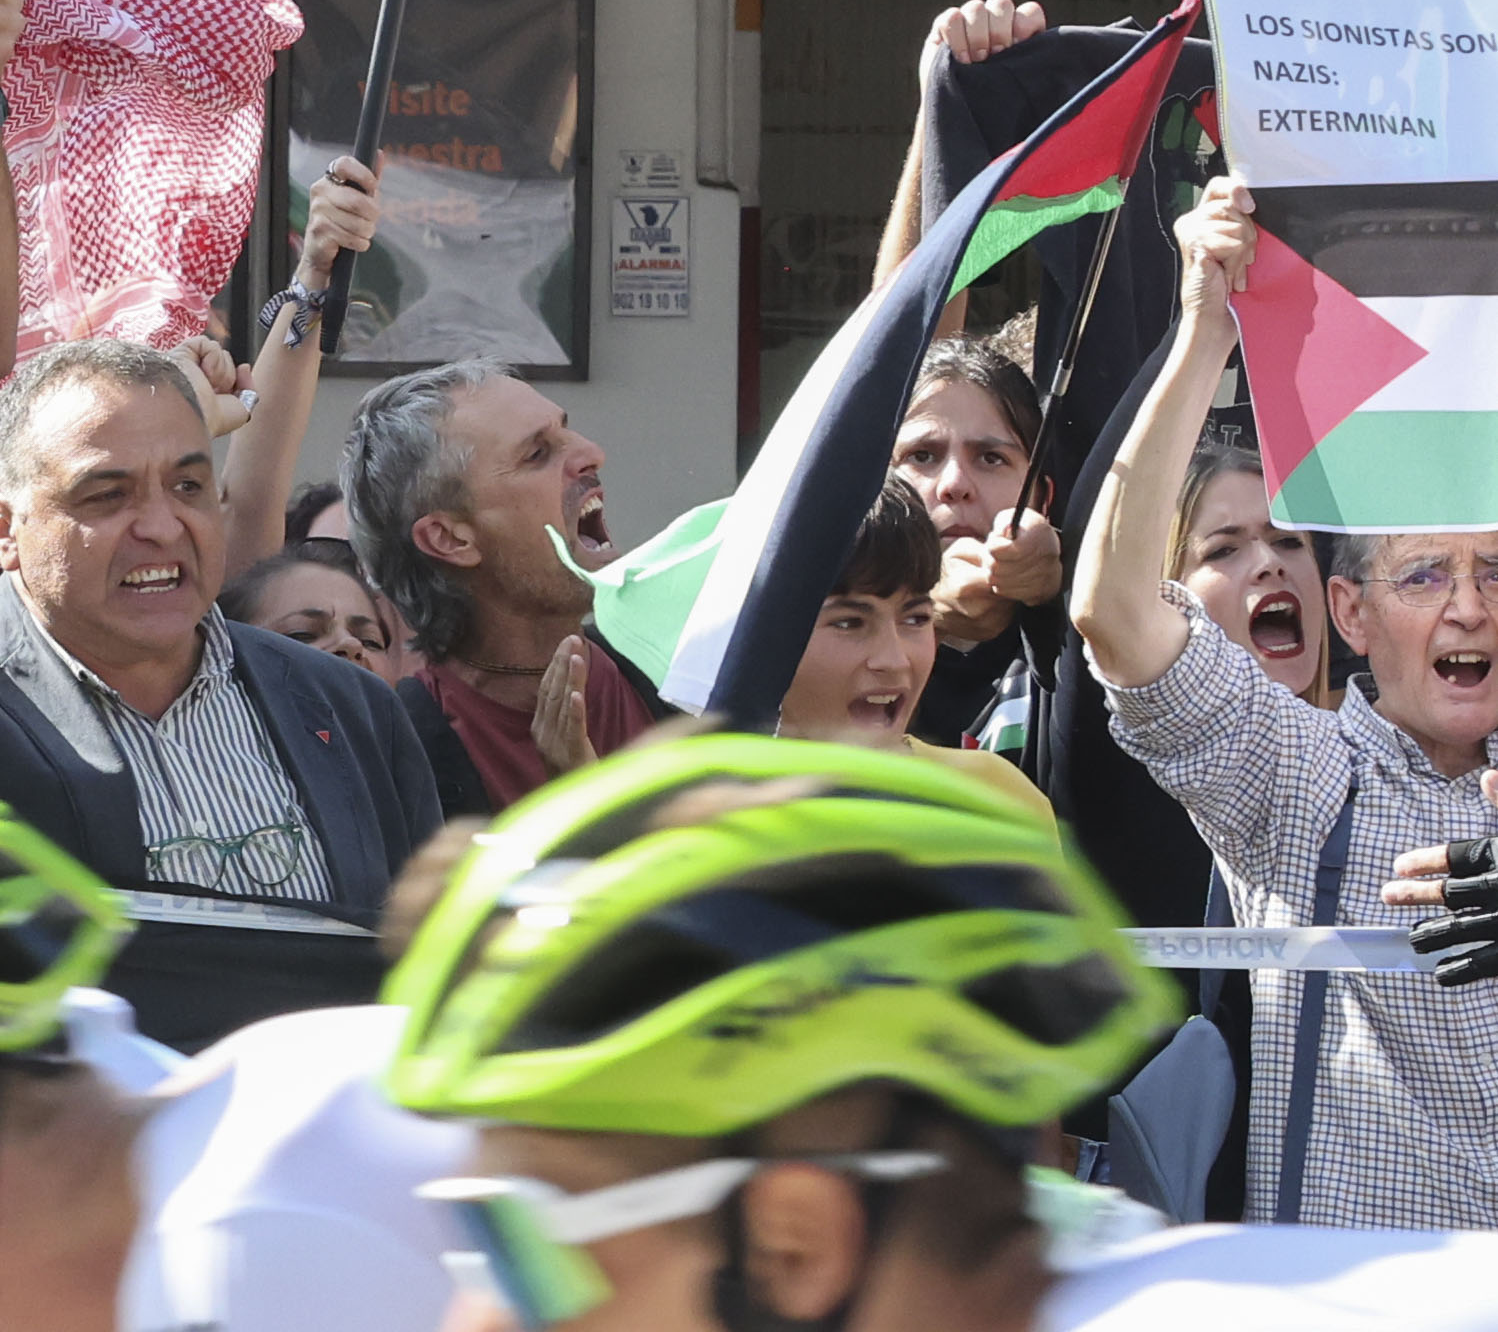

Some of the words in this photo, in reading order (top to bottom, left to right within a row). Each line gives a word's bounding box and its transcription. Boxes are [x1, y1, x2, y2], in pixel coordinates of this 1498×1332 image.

[1244, 13, 1294, 37] LOS
[1300, 19, 1435, 51] SIONISTAS
[1440, 32, 1498, 55] SON
[1252, 59, 1340, 86] NAZIS:
[1257, 108, 1438, 139] EXTERMINAN
